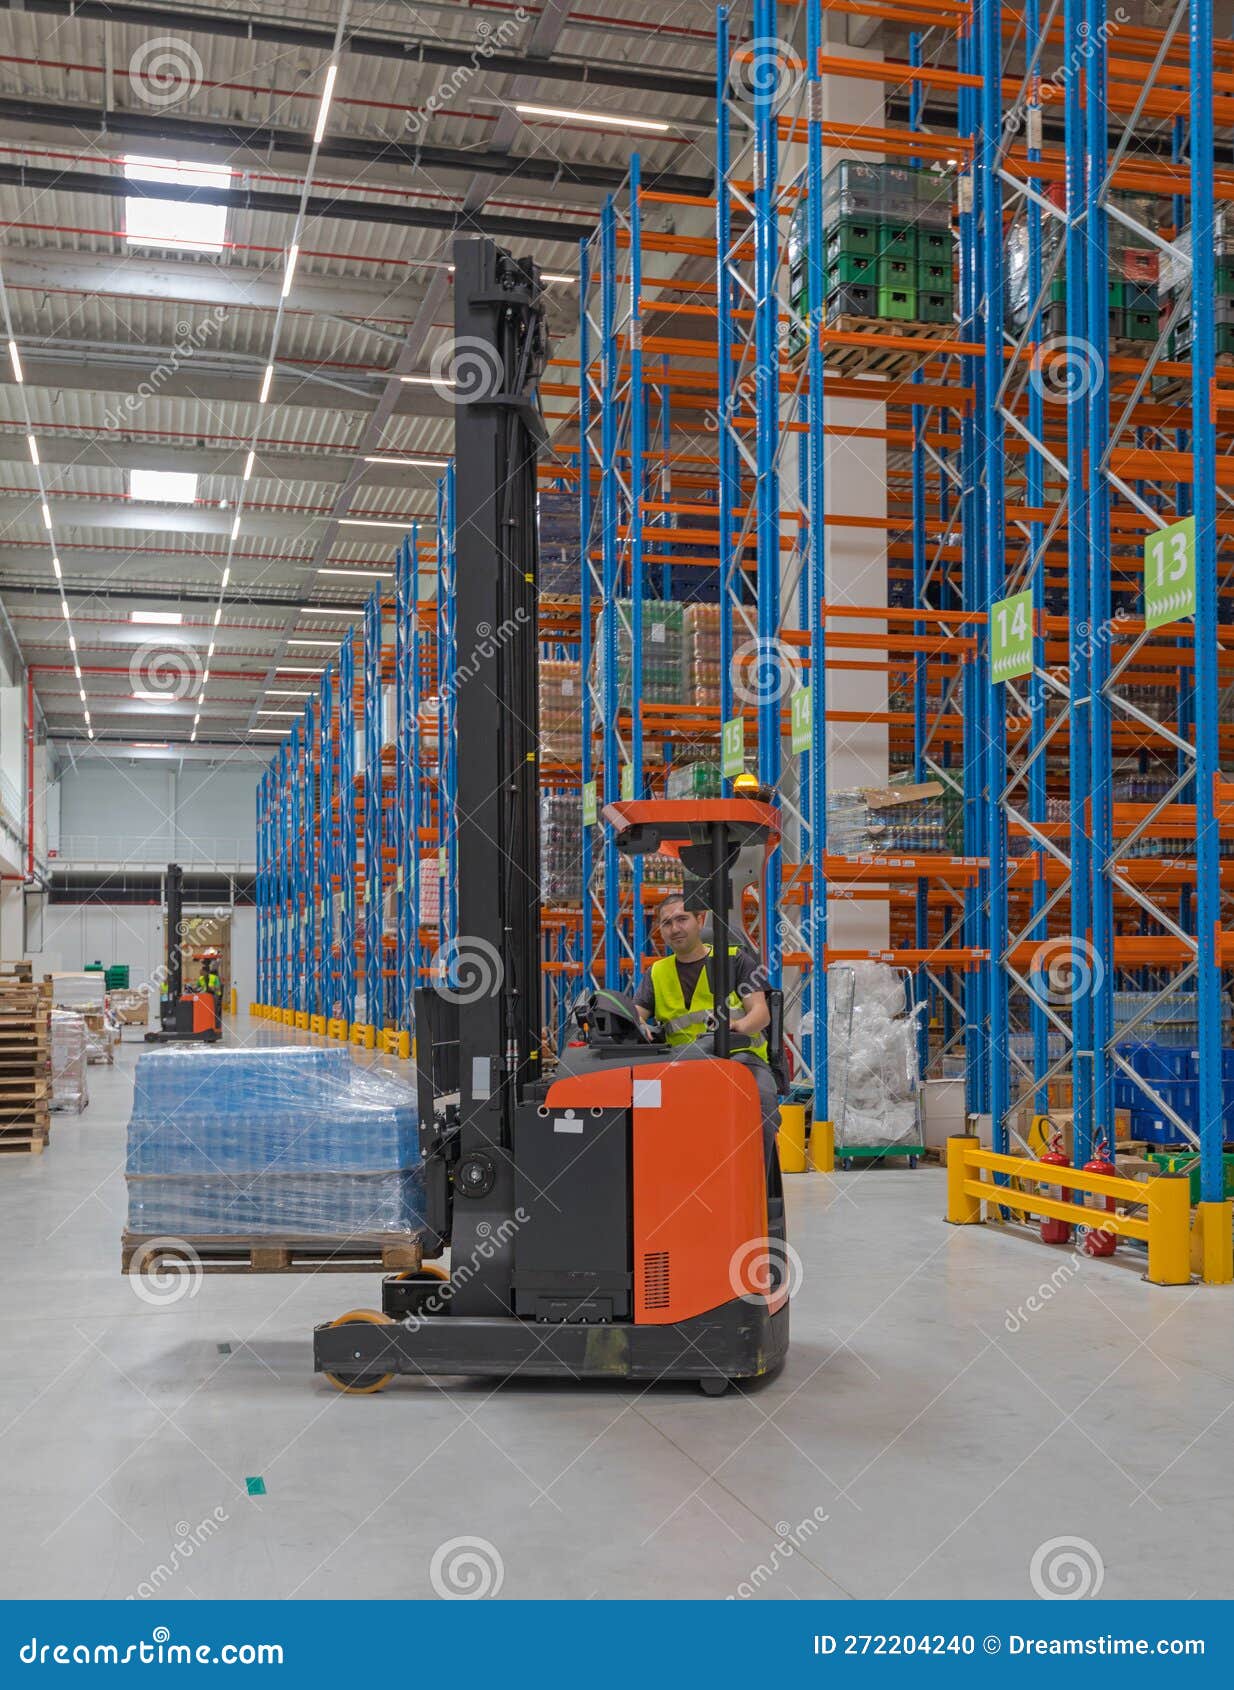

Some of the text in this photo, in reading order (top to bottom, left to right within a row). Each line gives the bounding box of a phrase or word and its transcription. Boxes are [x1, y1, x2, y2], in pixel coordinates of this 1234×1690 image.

[1152, 532, 1187, 587] 13
[997, 602, 1027, 647] 14
[795, 694, 809, 728] 14
[726, 724, 740, 754] 15
